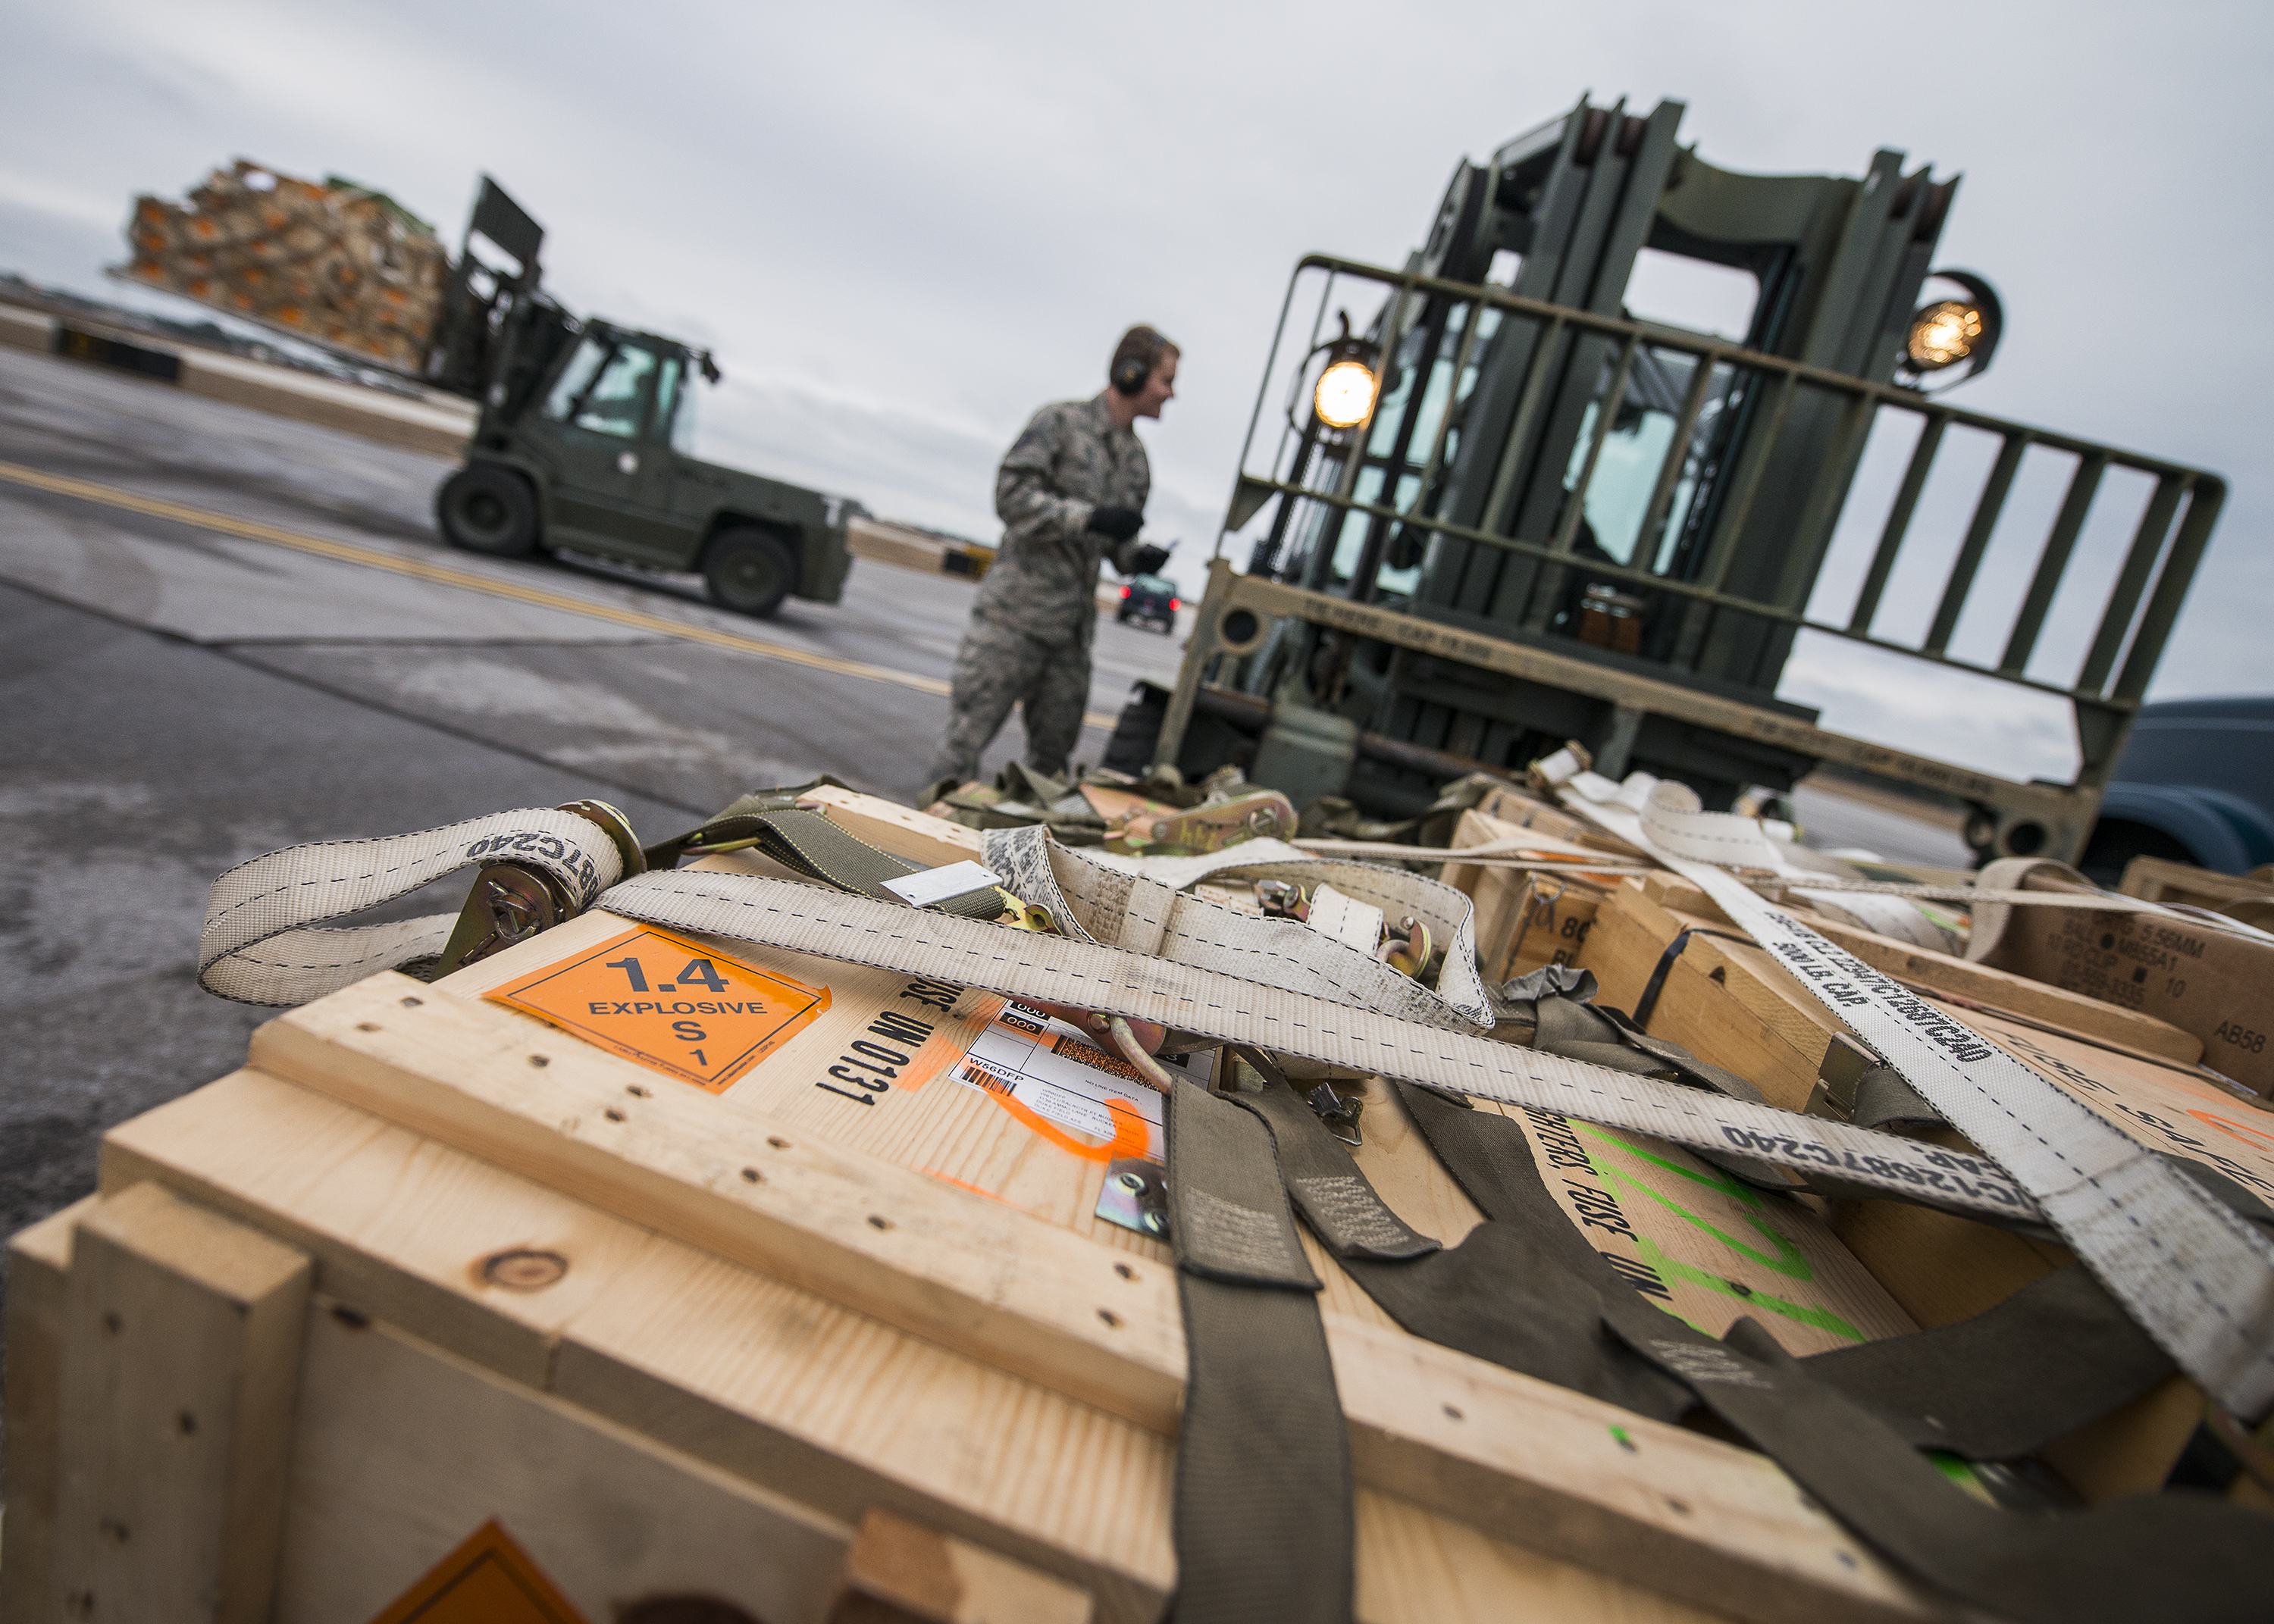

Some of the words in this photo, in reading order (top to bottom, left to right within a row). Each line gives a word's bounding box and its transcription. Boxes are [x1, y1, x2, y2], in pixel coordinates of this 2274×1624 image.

[606, 957, 730, 993] 1.4
[588, 1002, 768, 1015] EXPLOSIVE
[672, 1021, 706, 1041] S
[867, 1011, 935, 1048] UN
[2214, 1022, 2267, 1054] AB58
[689, 1049, 707, 1066] 1
[969, 1057, 1024, 1081] W56DFP
[815, 1040, 910, 1106] 0131
[1052, 1101, 1071, 1111] AMMO
[1123, 1093, 1139, 1102] DATA
[1561, 1178, 1639, 1243] FUSE
